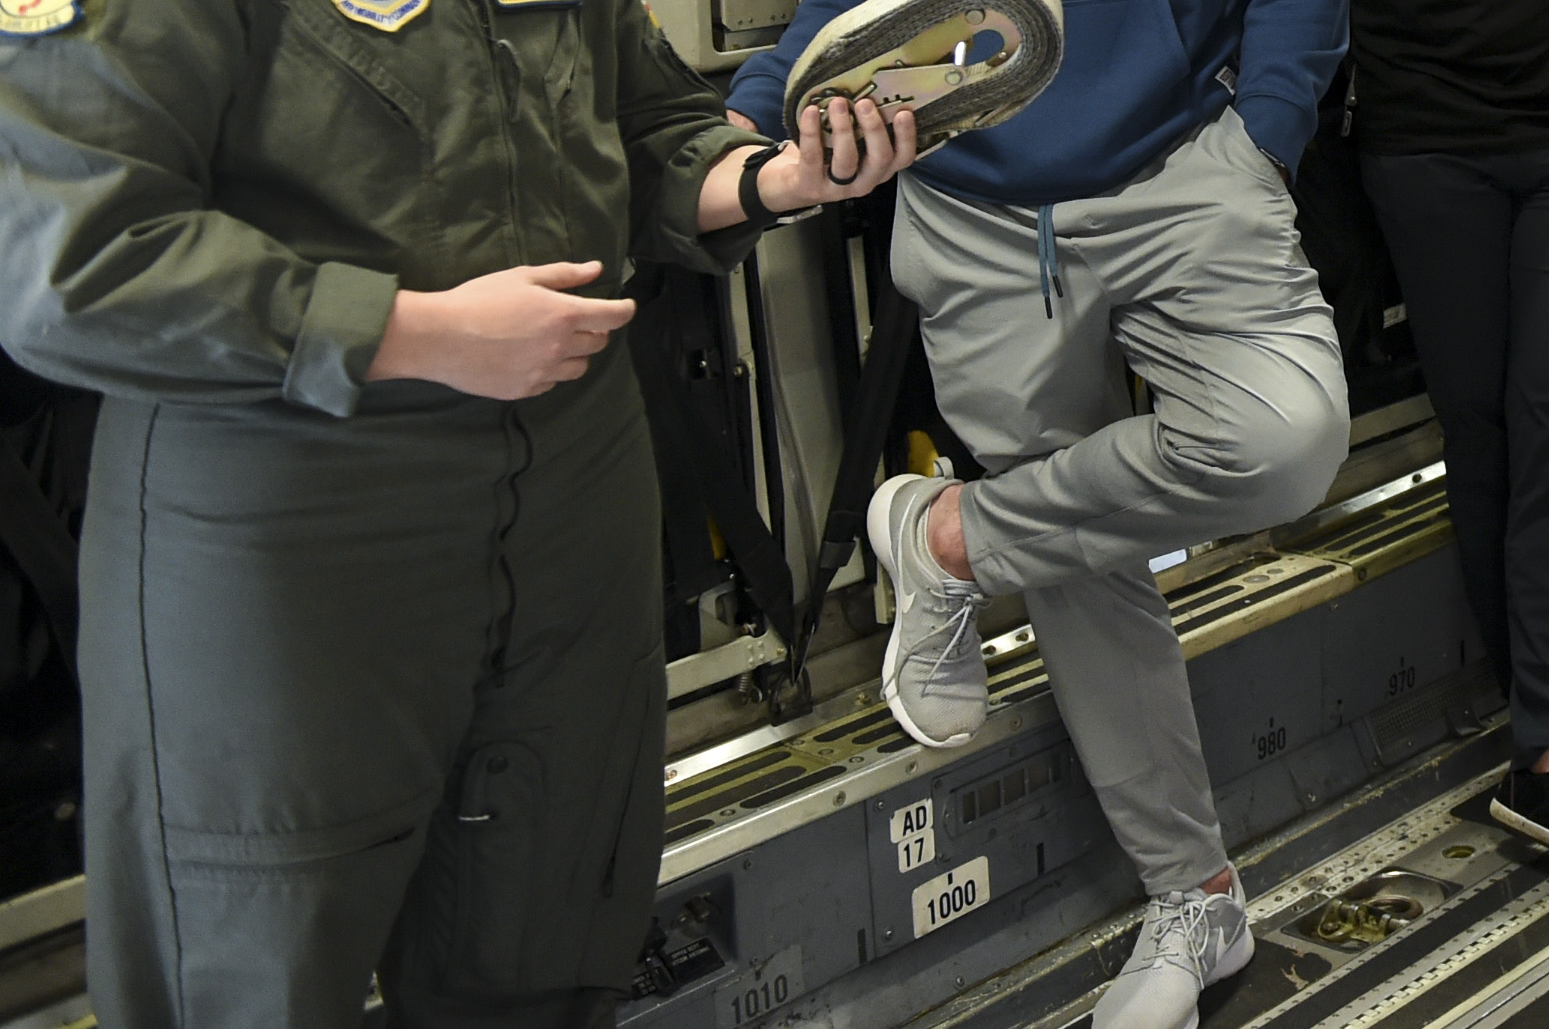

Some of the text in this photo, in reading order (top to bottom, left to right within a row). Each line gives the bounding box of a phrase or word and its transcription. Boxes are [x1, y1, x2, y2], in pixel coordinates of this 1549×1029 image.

[1389, 666, 1415, 696] 970
[1257, 727, 1286, 760] 980
[902, 805, 927, 836] AD
[903, 837, 924, 868] 17
[927, 879, 976, 925] 1000
[731, 974, 788, 1024] 1010
